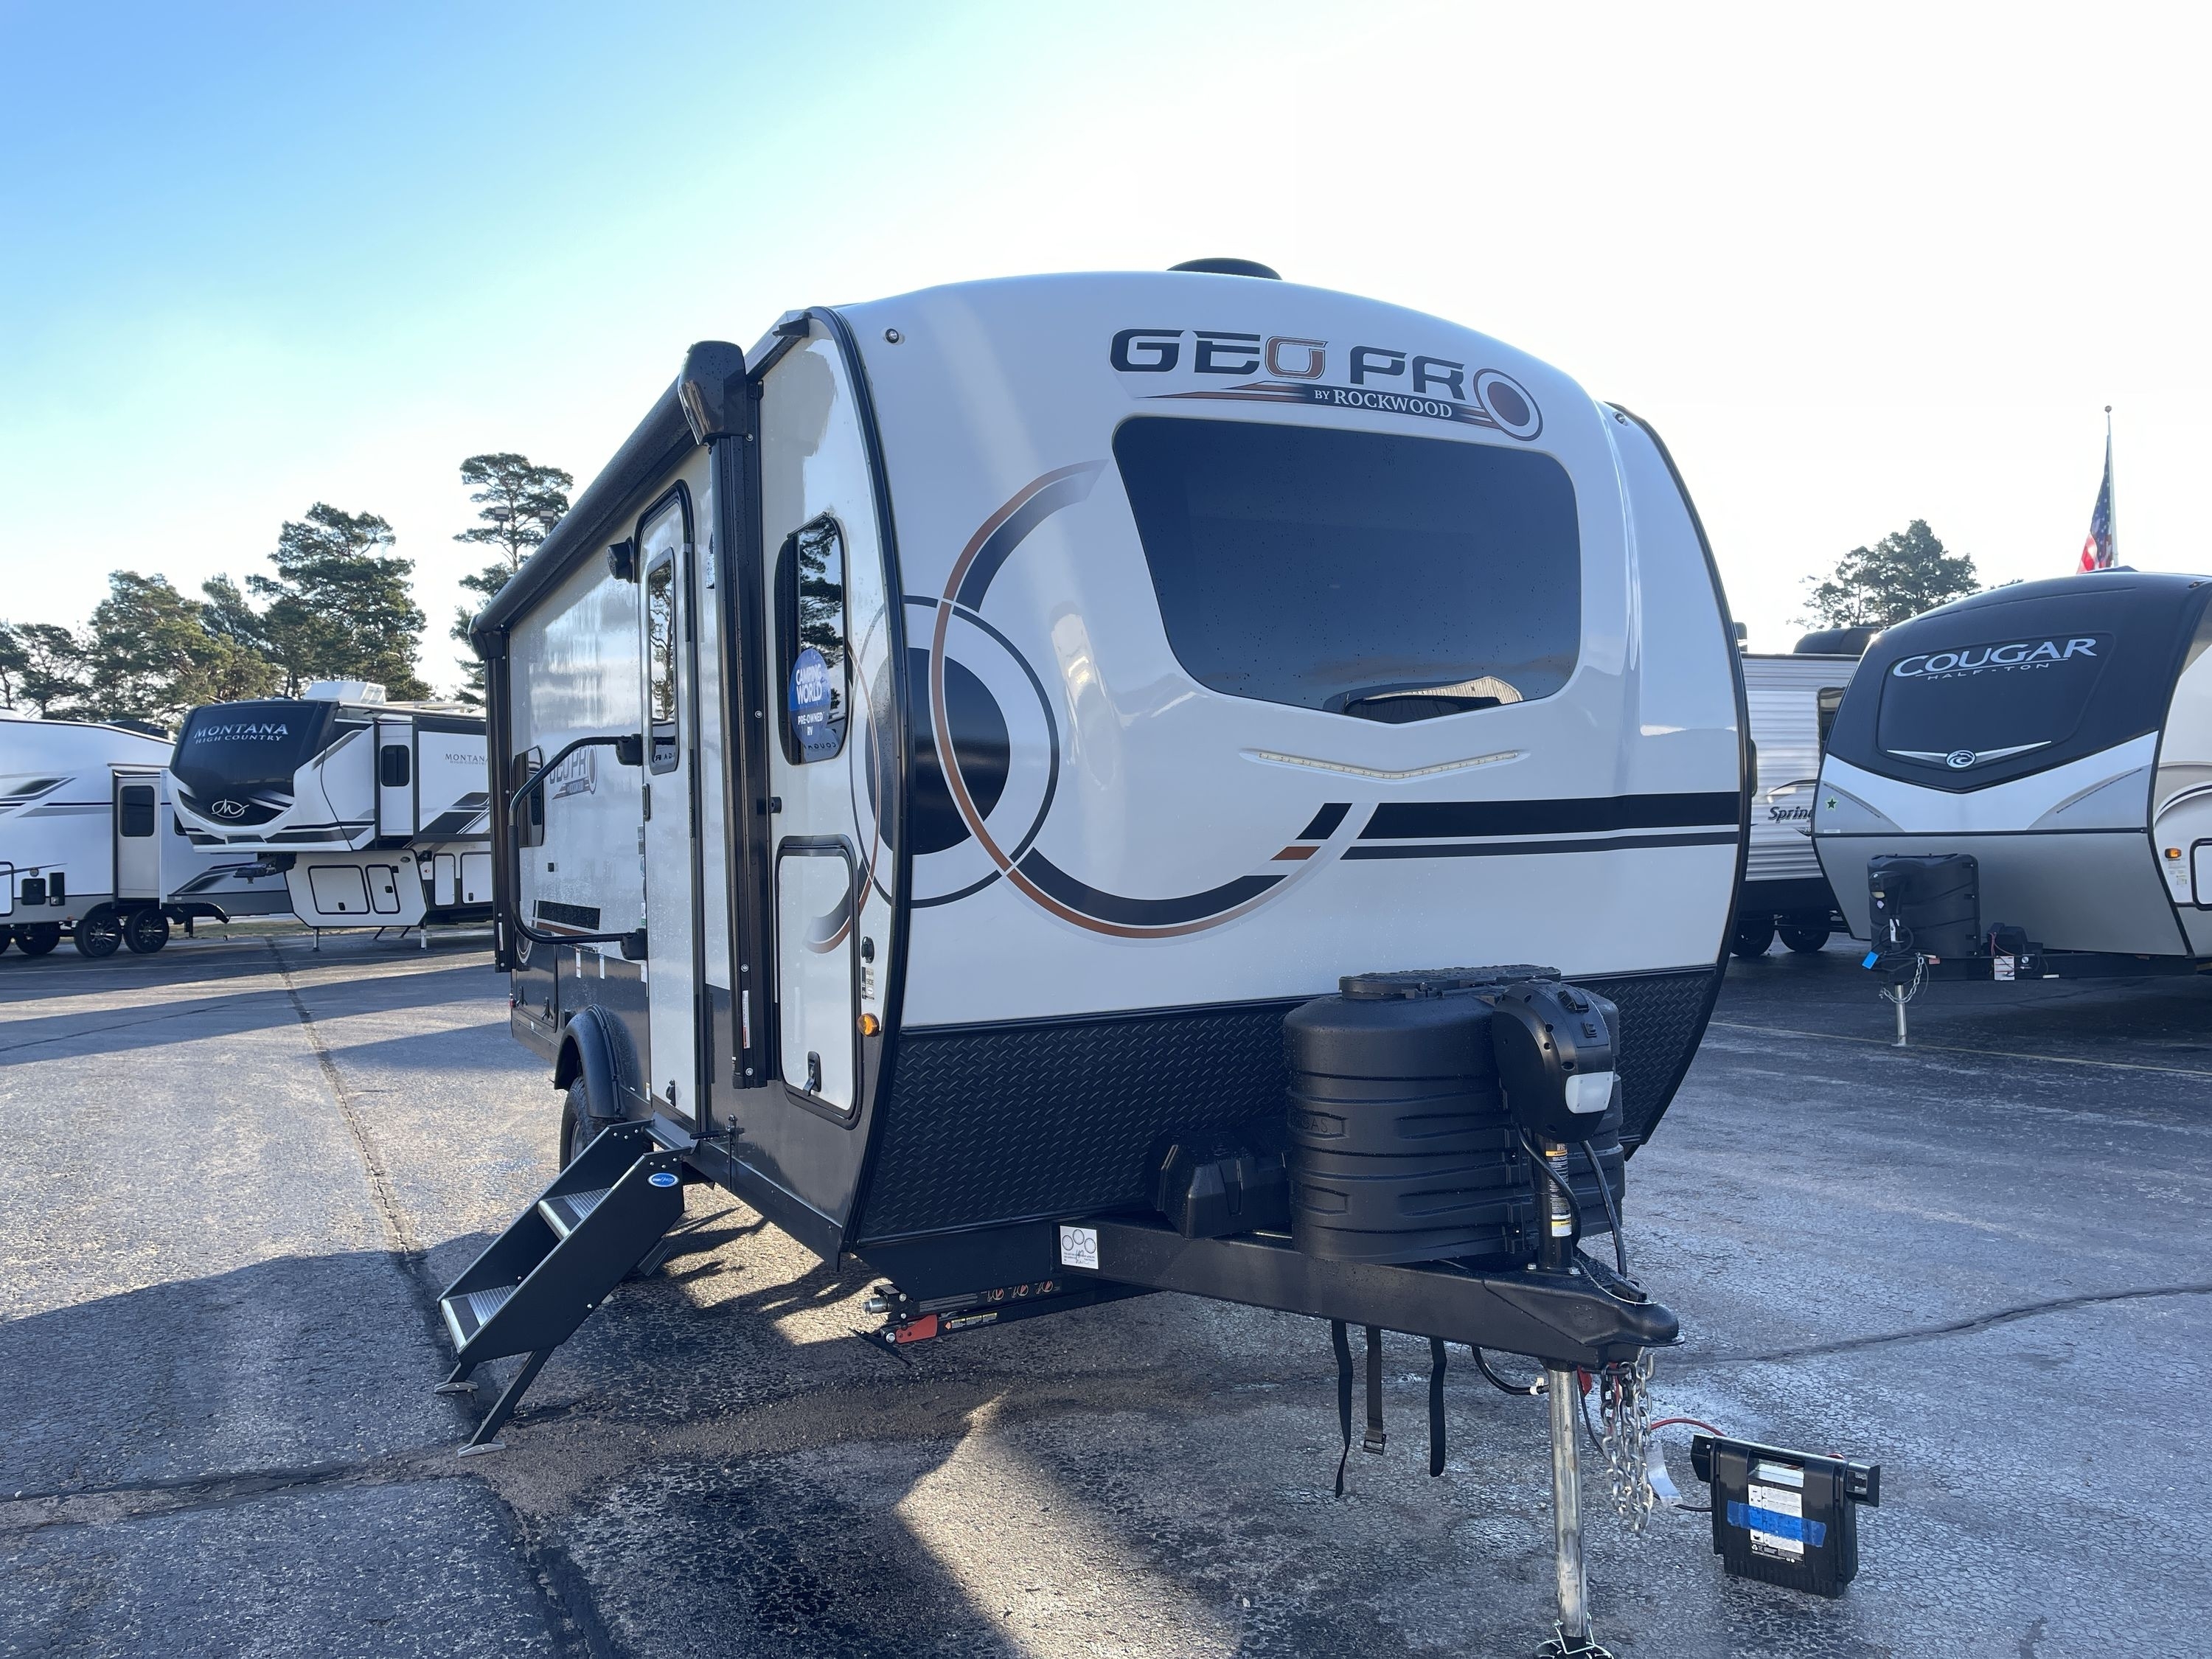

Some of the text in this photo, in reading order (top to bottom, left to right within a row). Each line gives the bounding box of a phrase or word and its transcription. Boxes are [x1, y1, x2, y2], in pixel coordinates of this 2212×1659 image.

[1110, 328, 1543, 442] GEO PRO
[1314, 389, 1453, 418] BY ROCKWOOD
[1893, 638, 2098, 677] COUGAR
[796, 664, 822, 686] CAMPING
[796, 681, 823, 705] WORLD
[797, 712, 824, 726] PRE-OWNED
[194, 723, 288, 739] MONTANA
[195, 736, 221, 745] HIGH
[807, 726, 813, 736] RV
[445, 753, 488, 762] MONTAN
[1301, 1114, 1328, 1133] GAS
